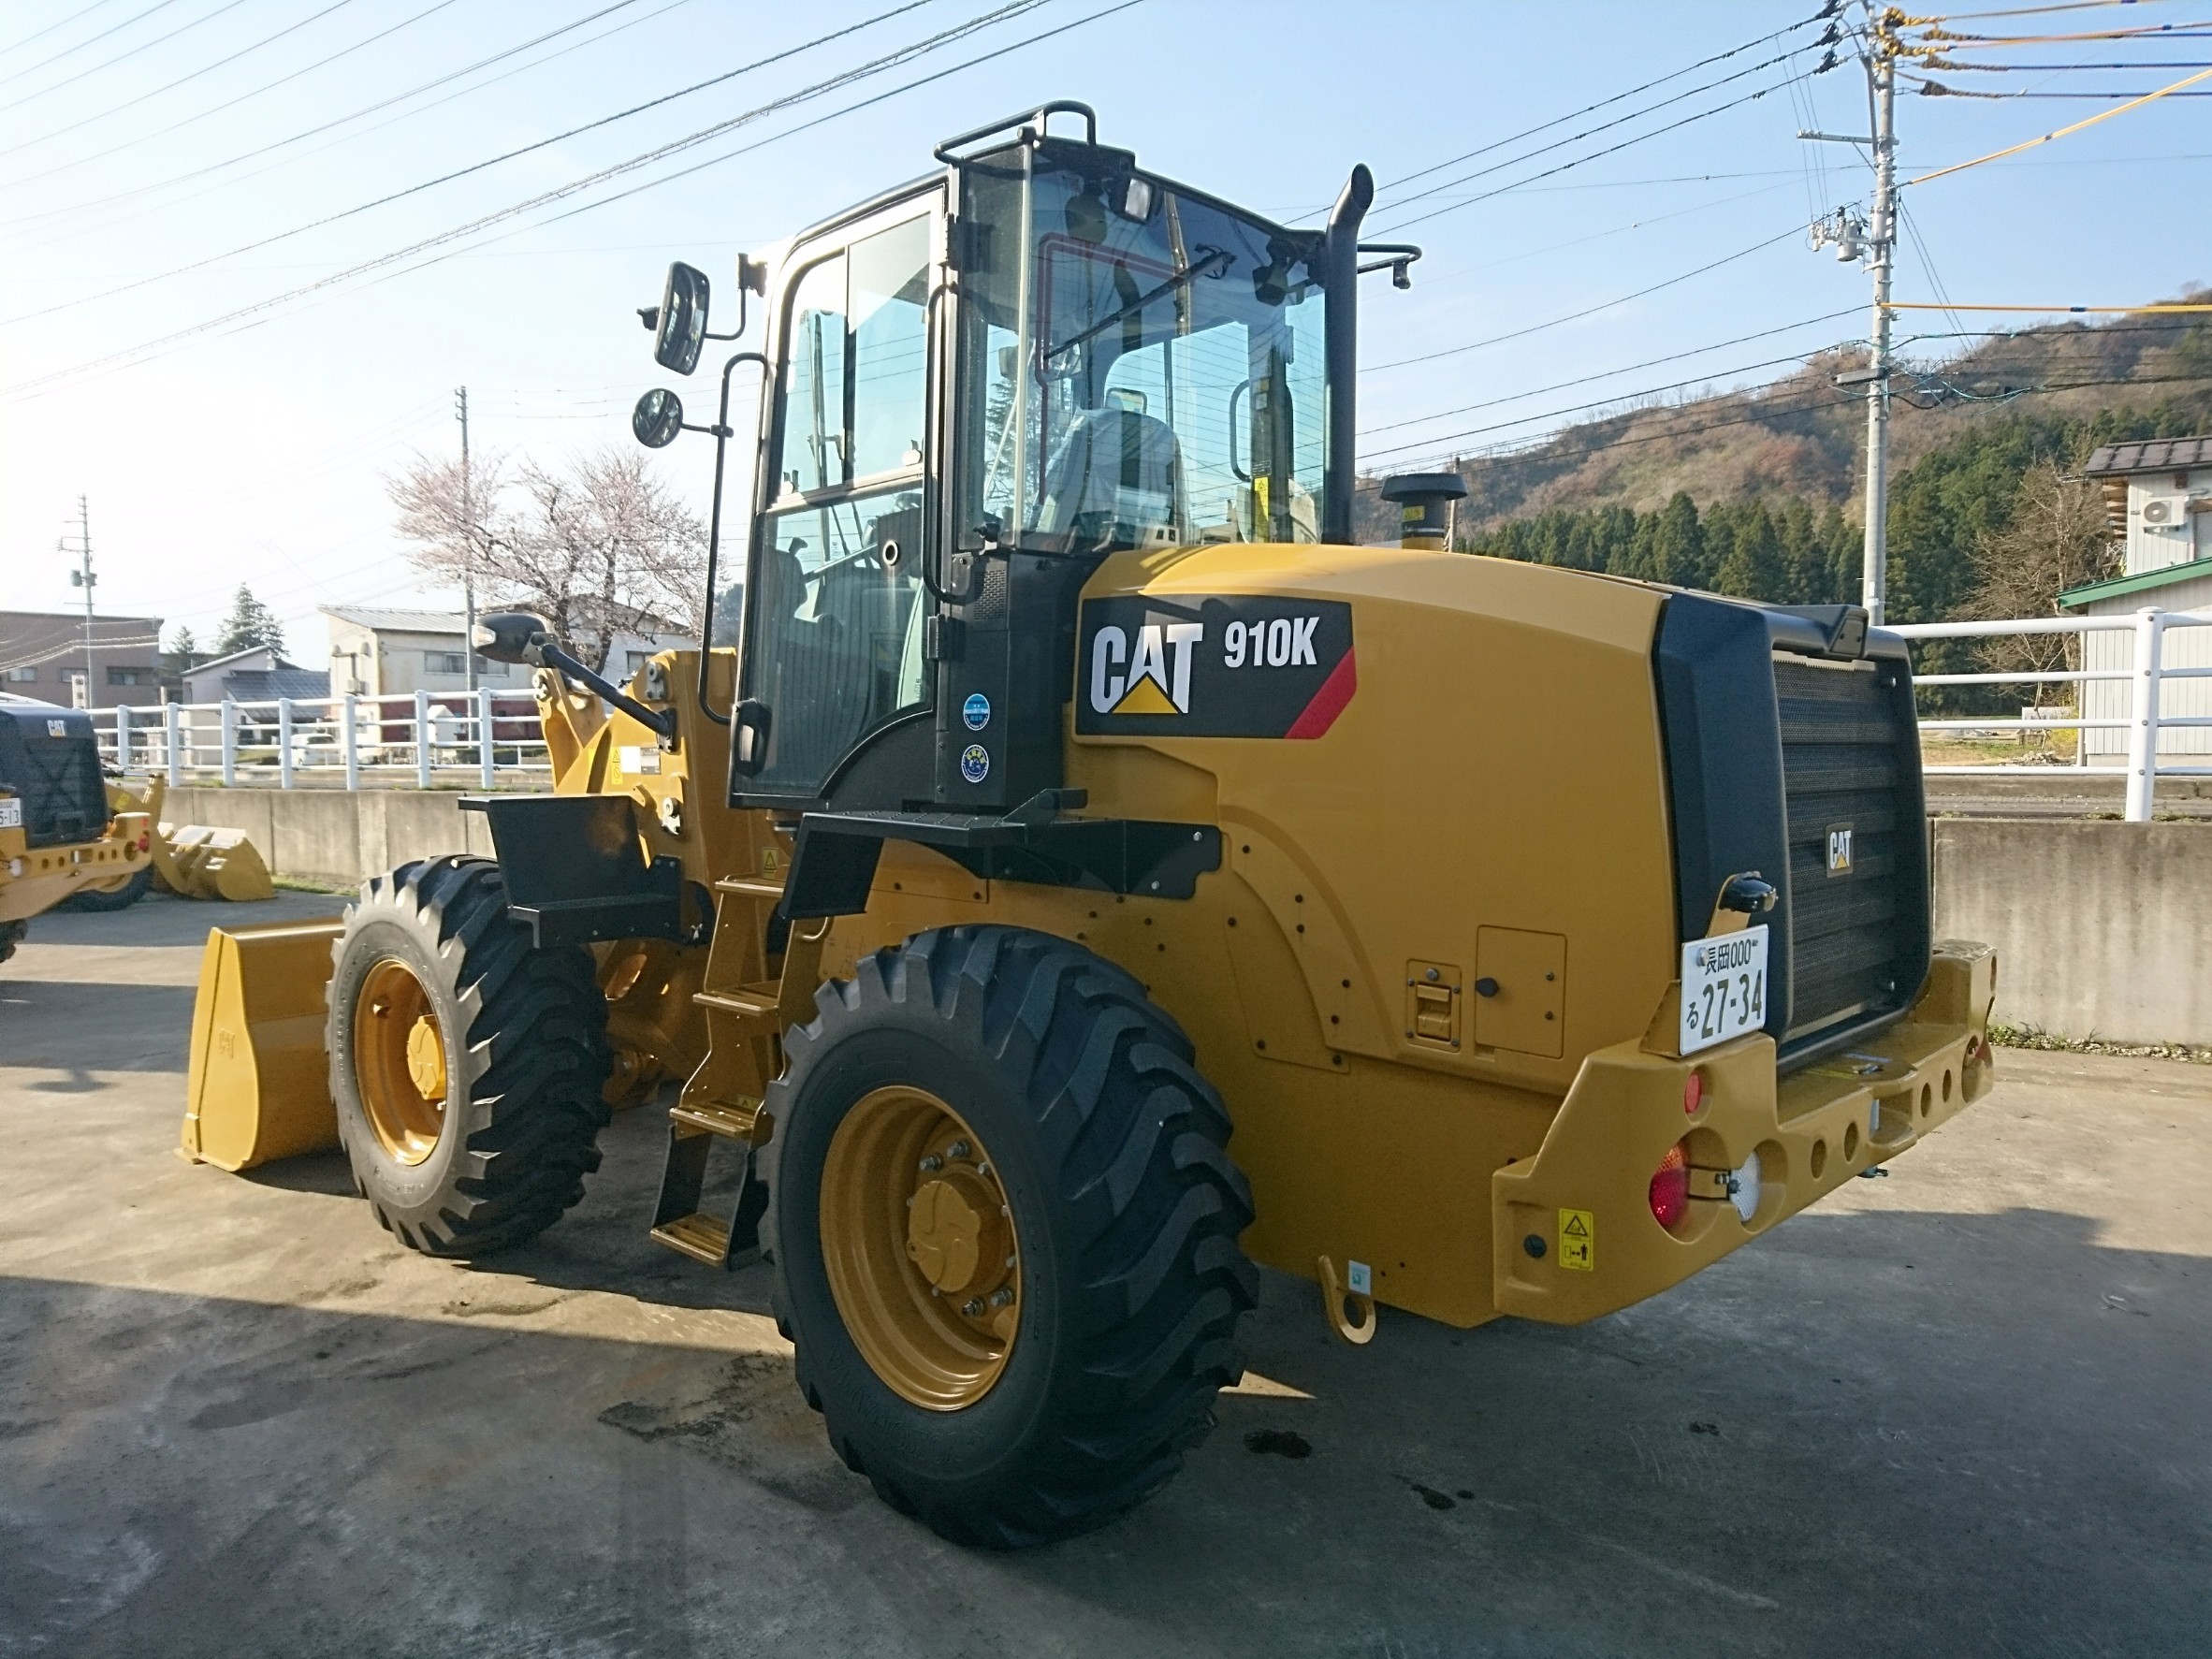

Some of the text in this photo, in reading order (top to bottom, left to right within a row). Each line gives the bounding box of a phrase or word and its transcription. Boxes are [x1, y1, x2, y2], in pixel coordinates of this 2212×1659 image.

[1090, 617, 1320, 714] CAT 910K
[47, 720, 66, 737] CAT
[1828, 830, 1852, 870] CAT
[1687, 969, 1763, 1040] る 27-34
